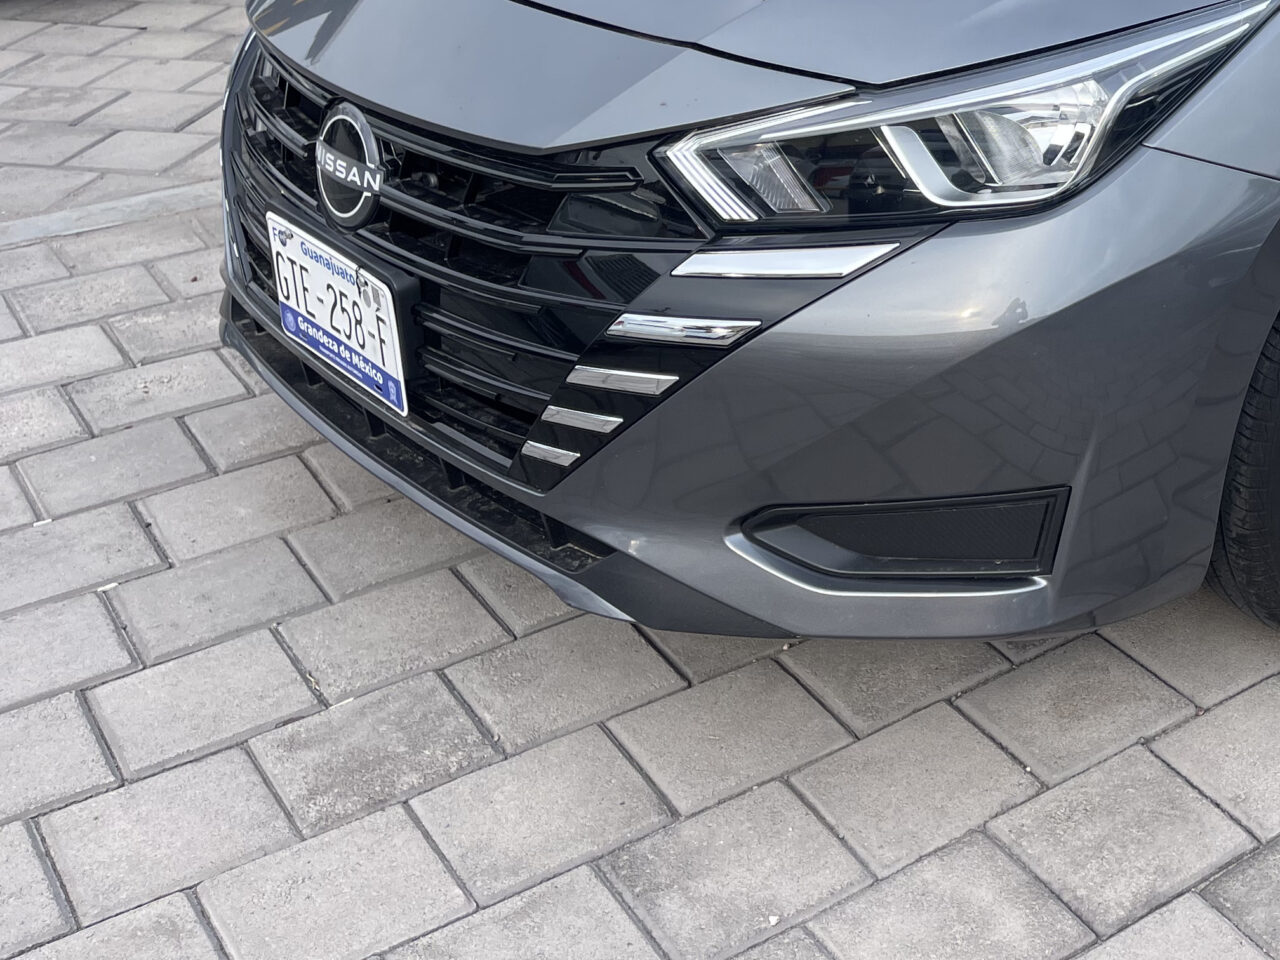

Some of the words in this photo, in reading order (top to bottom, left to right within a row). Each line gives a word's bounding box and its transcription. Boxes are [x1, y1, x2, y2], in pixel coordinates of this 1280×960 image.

[316, 141, 381, 192] NISSAN
[300, 240, 356, 286] Guanajuato
[297, 316, 339, 353] Grandeza
[339, 344, 352, 362] de
[351, 352, 384, 385] México
